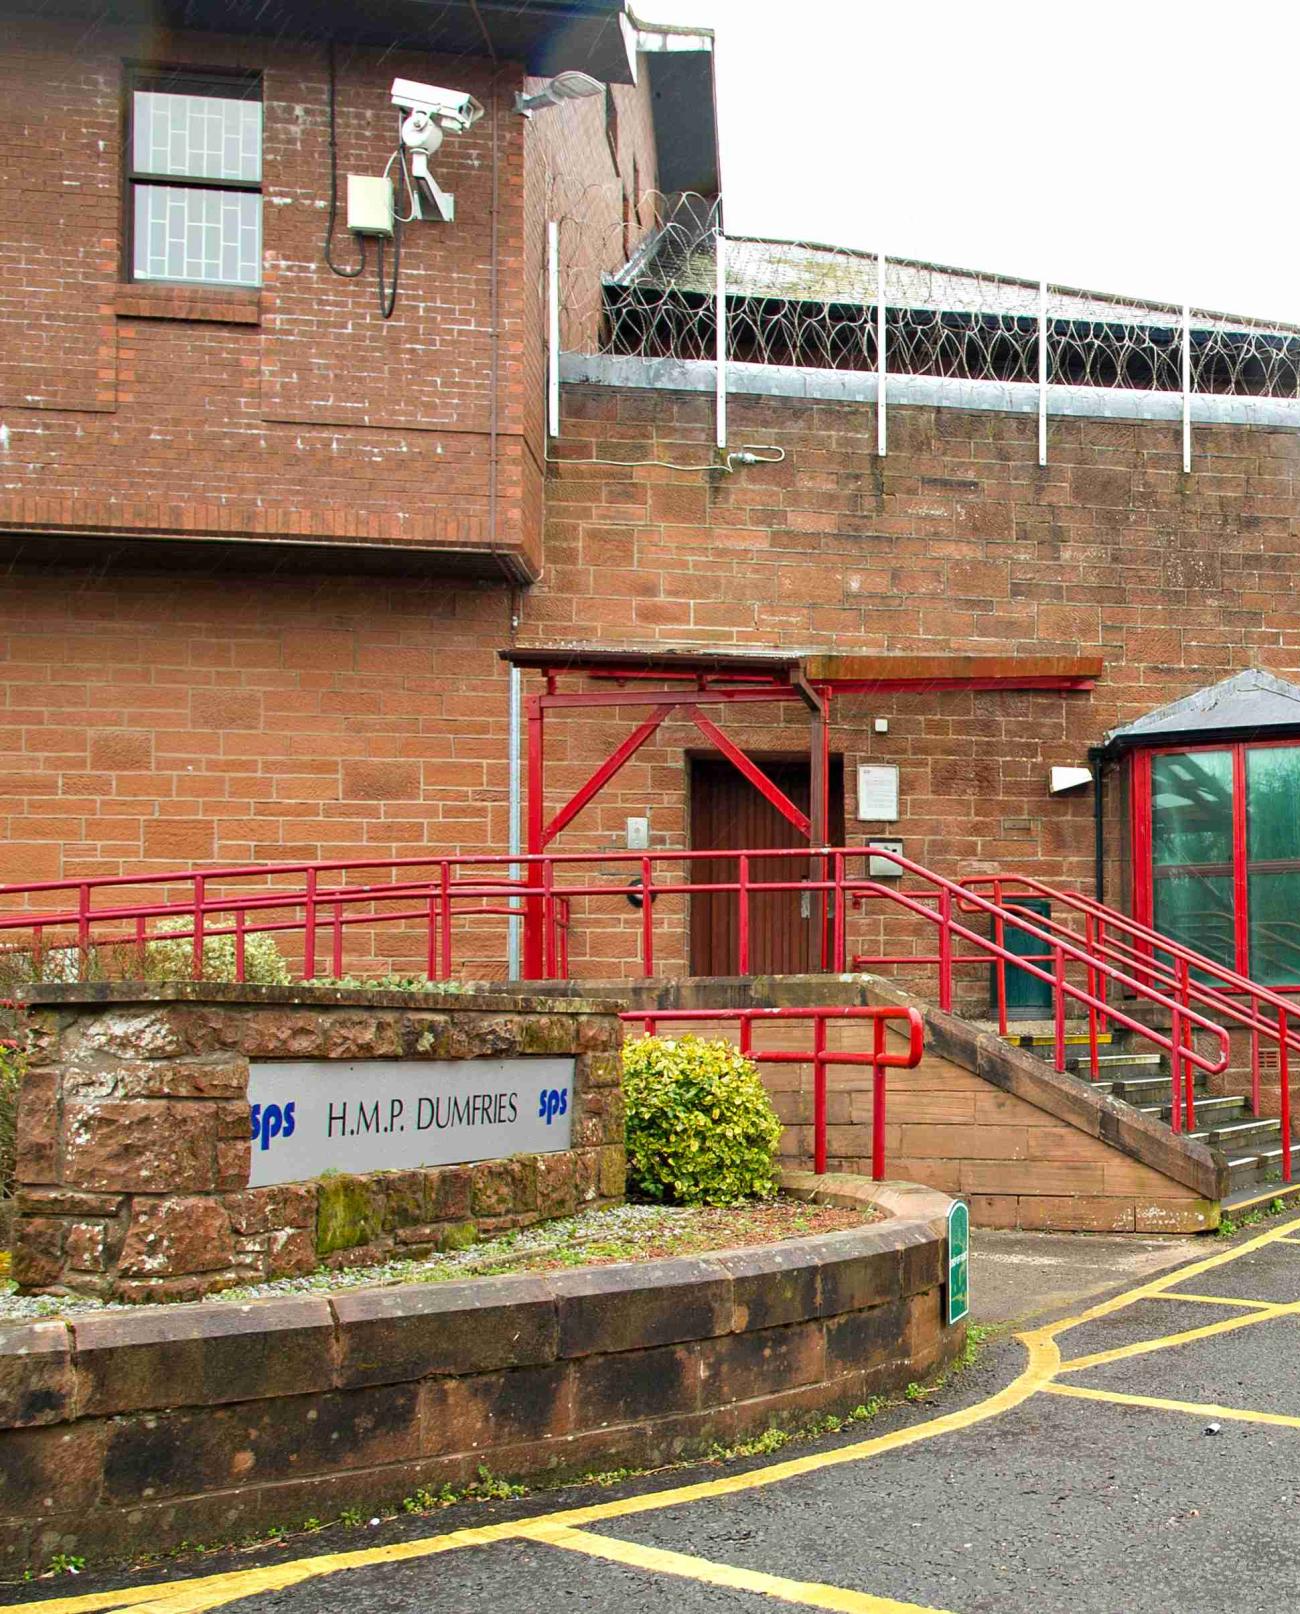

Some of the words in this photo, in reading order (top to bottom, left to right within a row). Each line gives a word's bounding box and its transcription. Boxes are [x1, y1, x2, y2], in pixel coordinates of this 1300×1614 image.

[250, 1101, 296, 1151] sps
[327, 1099, 405, 1138] H.M.P.
[416, 1092, 519, 1131] DUMFRIES
[538, 1087, 568, 1125] sps
